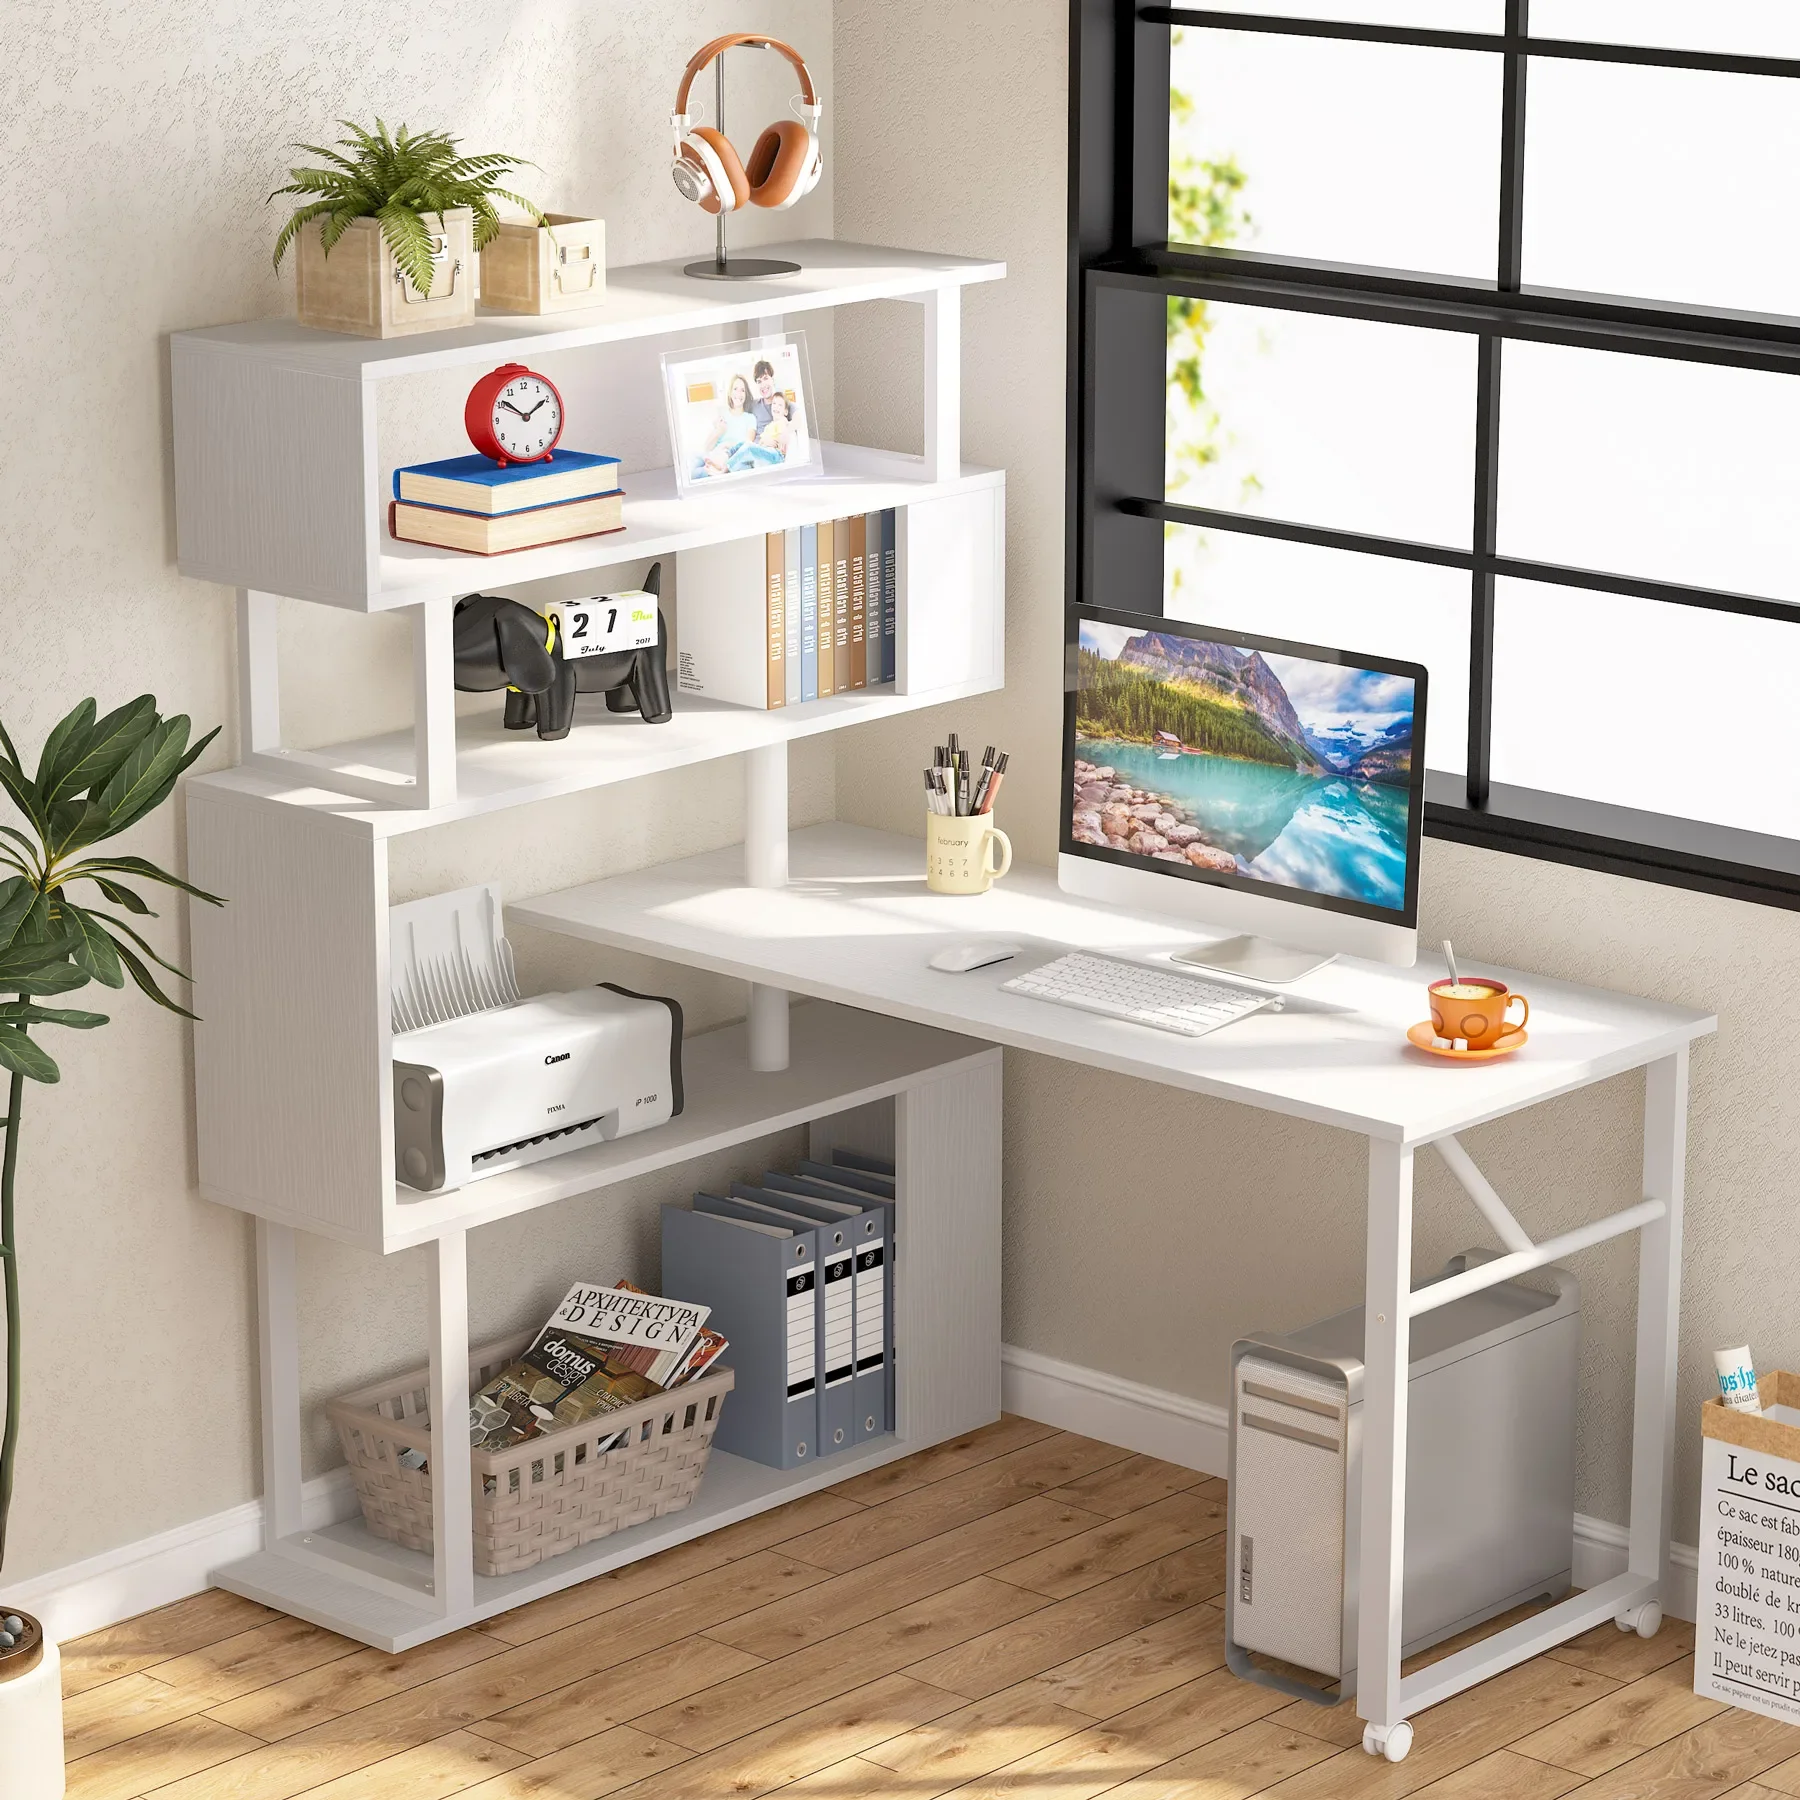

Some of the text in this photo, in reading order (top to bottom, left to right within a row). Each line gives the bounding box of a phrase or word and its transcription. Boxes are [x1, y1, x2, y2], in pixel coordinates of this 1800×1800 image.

[520, 382, 528, 390] 12
[538, 439, 543, 447] 5
[581, 644, 606, 654] July
[635, 637, 651, 645] 2011
[544, 1052, 570, 1065] Canon
[547, 1104, 565, 1114] PIXMA
[643, 1094, 657, 1104] 1000
[568, 1289, 699, 1327] АРХИТЕКТУРА
[543, 1338, 596, 1374] domus
[546, 1357, 587, 1387] design
[1727, 1453, 1800, 1498] Le sac
[1717, 1500, 1736, 1518] Ce
[1739, 1509, 1758, 1524] sac
[1761, 1515, 1778, 1531] est
[1717, 1526, 1774, 1555] épaisseur
[1718, 1551, 1739, 1570] 100
[1742, 1558, 1755, 1575] %
[1715, 1576, 1760, 1603] doublé
[1765, 1591, 1781, 1609] de
[1715, 1602, 1795, 1639] 33 litres. 100
[1714, 1626, 1733, 1646] Ne
[1736, 1632, 1746, 1650] le
[1748, 1637, 1778, 1659] jetez
[1714, 1651, 1722, 1668] Il
[1725, 1659, 1753, 1678] peut
[1755, 1668, 1790, 1689] servir
